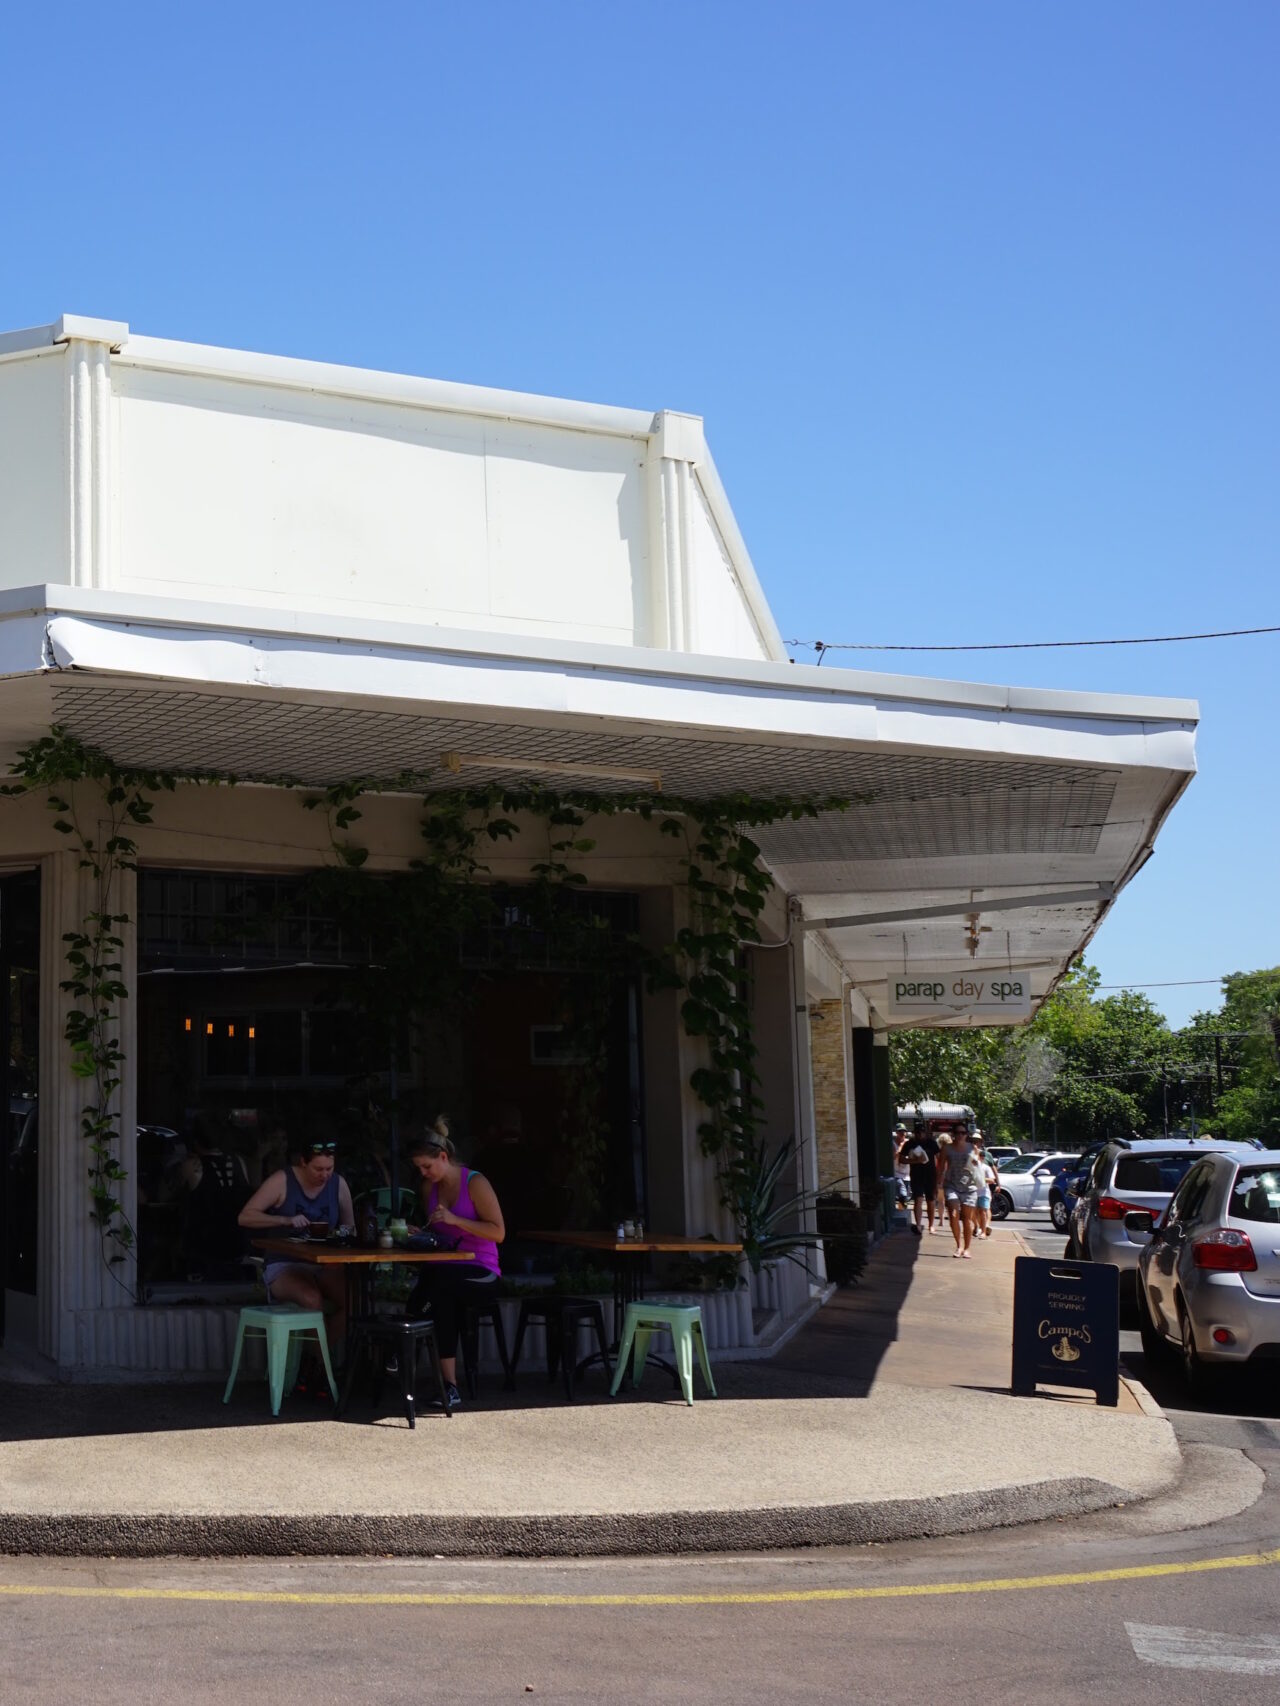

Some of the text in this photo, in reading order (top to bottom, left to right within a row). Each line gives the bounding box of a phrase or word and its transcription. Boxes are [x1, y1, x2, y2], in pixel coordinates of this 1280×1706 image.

[895, 978, 1023, 1001] parap day spa
[1048, 1292, 1086, 1302] PROUDLY
[1048, 1301, 1085, 1311] SERVING
